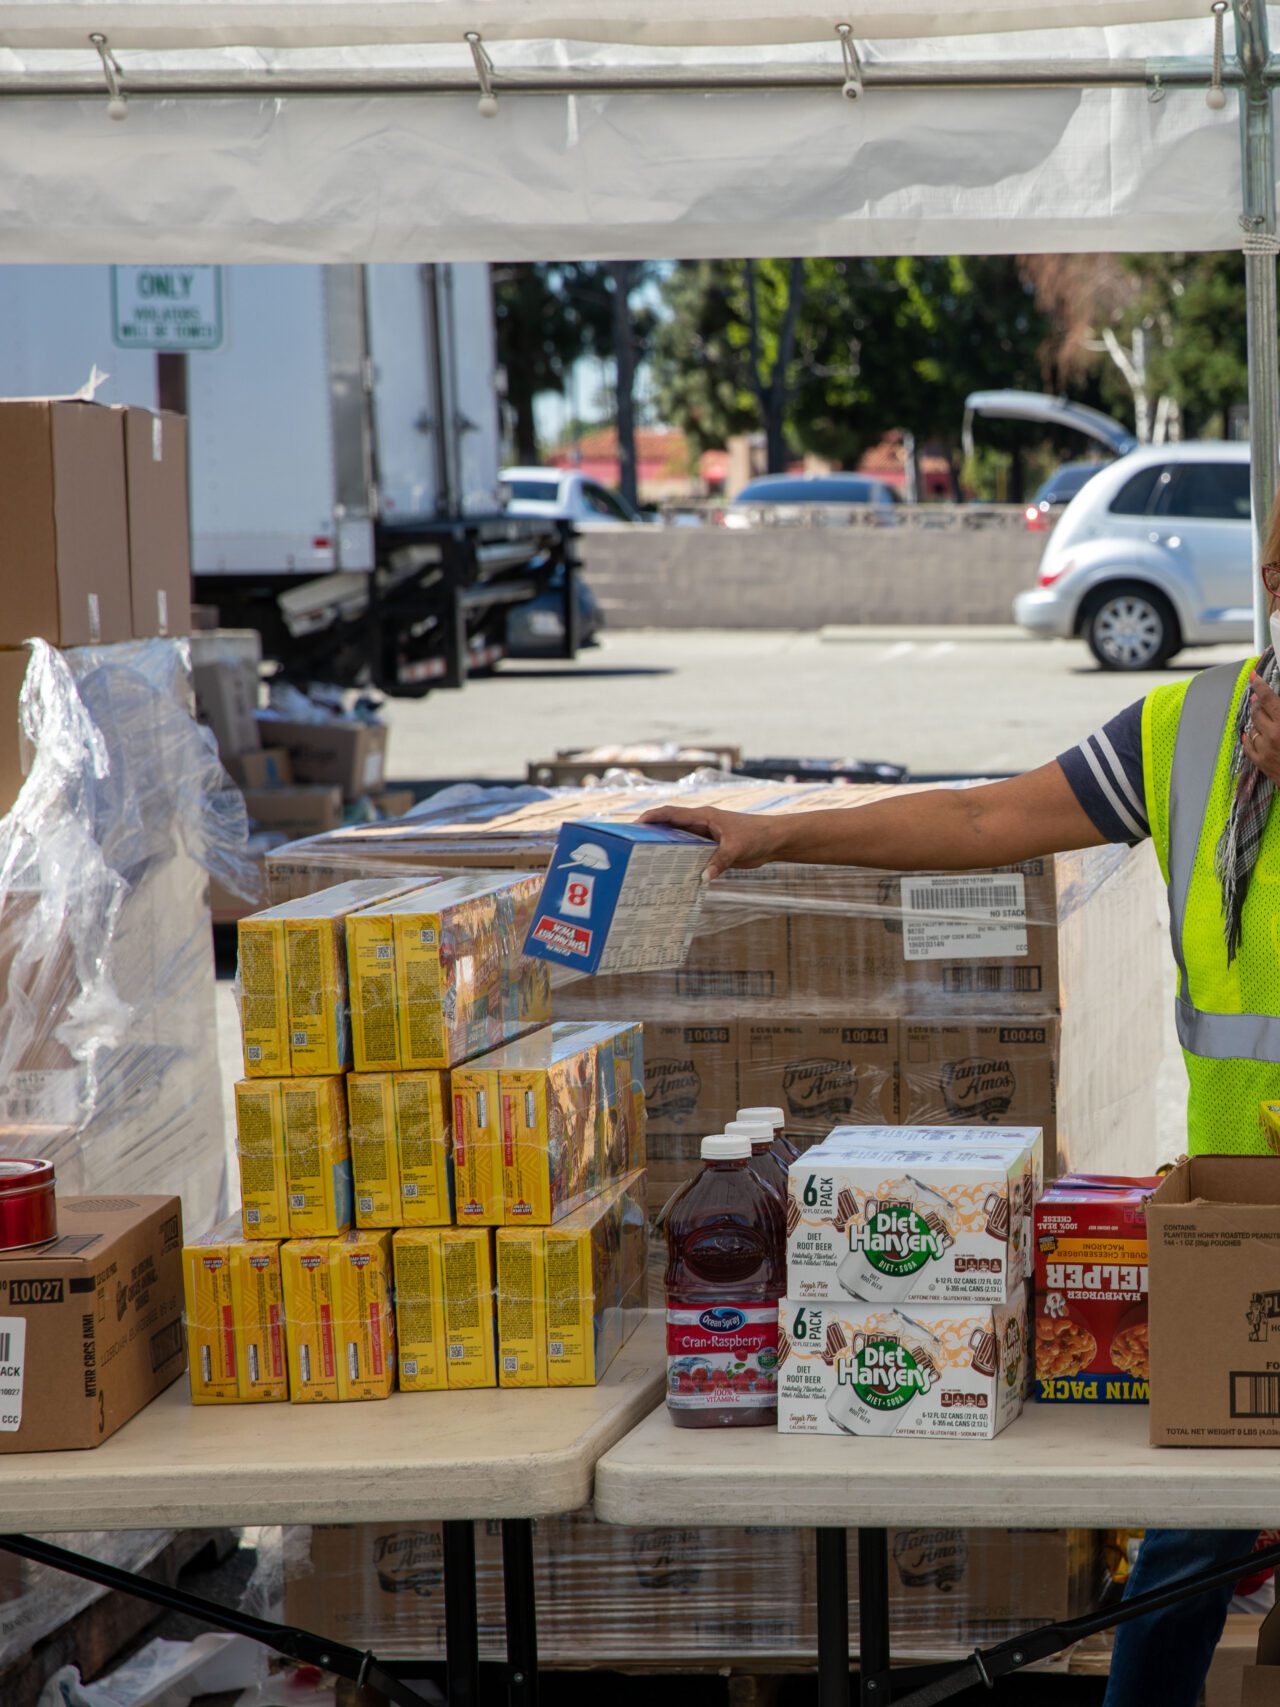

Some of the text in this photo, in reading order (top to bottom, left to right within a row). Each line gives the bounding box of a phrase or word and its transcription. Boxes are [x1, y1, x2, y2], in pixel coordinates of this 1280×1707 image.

[137, 271, 194, 299] ONLY
[567, 882, 589, 907] 8
[990, 909, 1026, 918] NO STACK
[686, 1028, 728, 1041] 10046
[845, 1028, 886, 1041] 10046
[1003, 1028, 1043, 1041] 10046
[644, 1060, 695, 1079] amous
[784, 1059, 854, 1088] Famous
[942, 1060, 1010, 1087] Famous
[651, 1076, 698, 1099] Amos
[801, 1074, 856, 1099] Amos
[959, 1075, 1013, 1099] Amos
[803, 1174, 833, 1207] 6 PACK
[877, 1211, 921, 1233] Diet
[797, 1242, 832, 1251] ROOT BEER
[807, 1233, 822, 1241] DIET
[850, 1224, 945, 1258] Hansen's
[878, 1259, 918, 1274] DIET SODA
[12, 1281, 62, 1302] 10027
[1067, 1291, 1141, 1301] HAMBURGER
[702, 1315, 740, 1329] Ocean Spray
[793, 1307, 822, 1340] 6 PACK
[83, 1340, 96, 1368] CRCS
[865, 1346, 908, 1367] Diet
[786, 1375, 821, 1384] ROOT BEER
[797, 1366, 811, 1374] DIET
[839, 1358, 931, 1392] Hansen's
[84, 1369, 96, 1398] MTHR
[714, 1387, 733, 1396] 100%
[1041, 1381, 1099, 1399] PACK
[866, 1394, 904, 1407] DIET SODA
[2, 1415, 19, 1424] CCC
[948, 1412, 964, 1420] CANS
[374, 1531, 441, 1562] Famous
[897, 1530, 966, 1558] Famous
